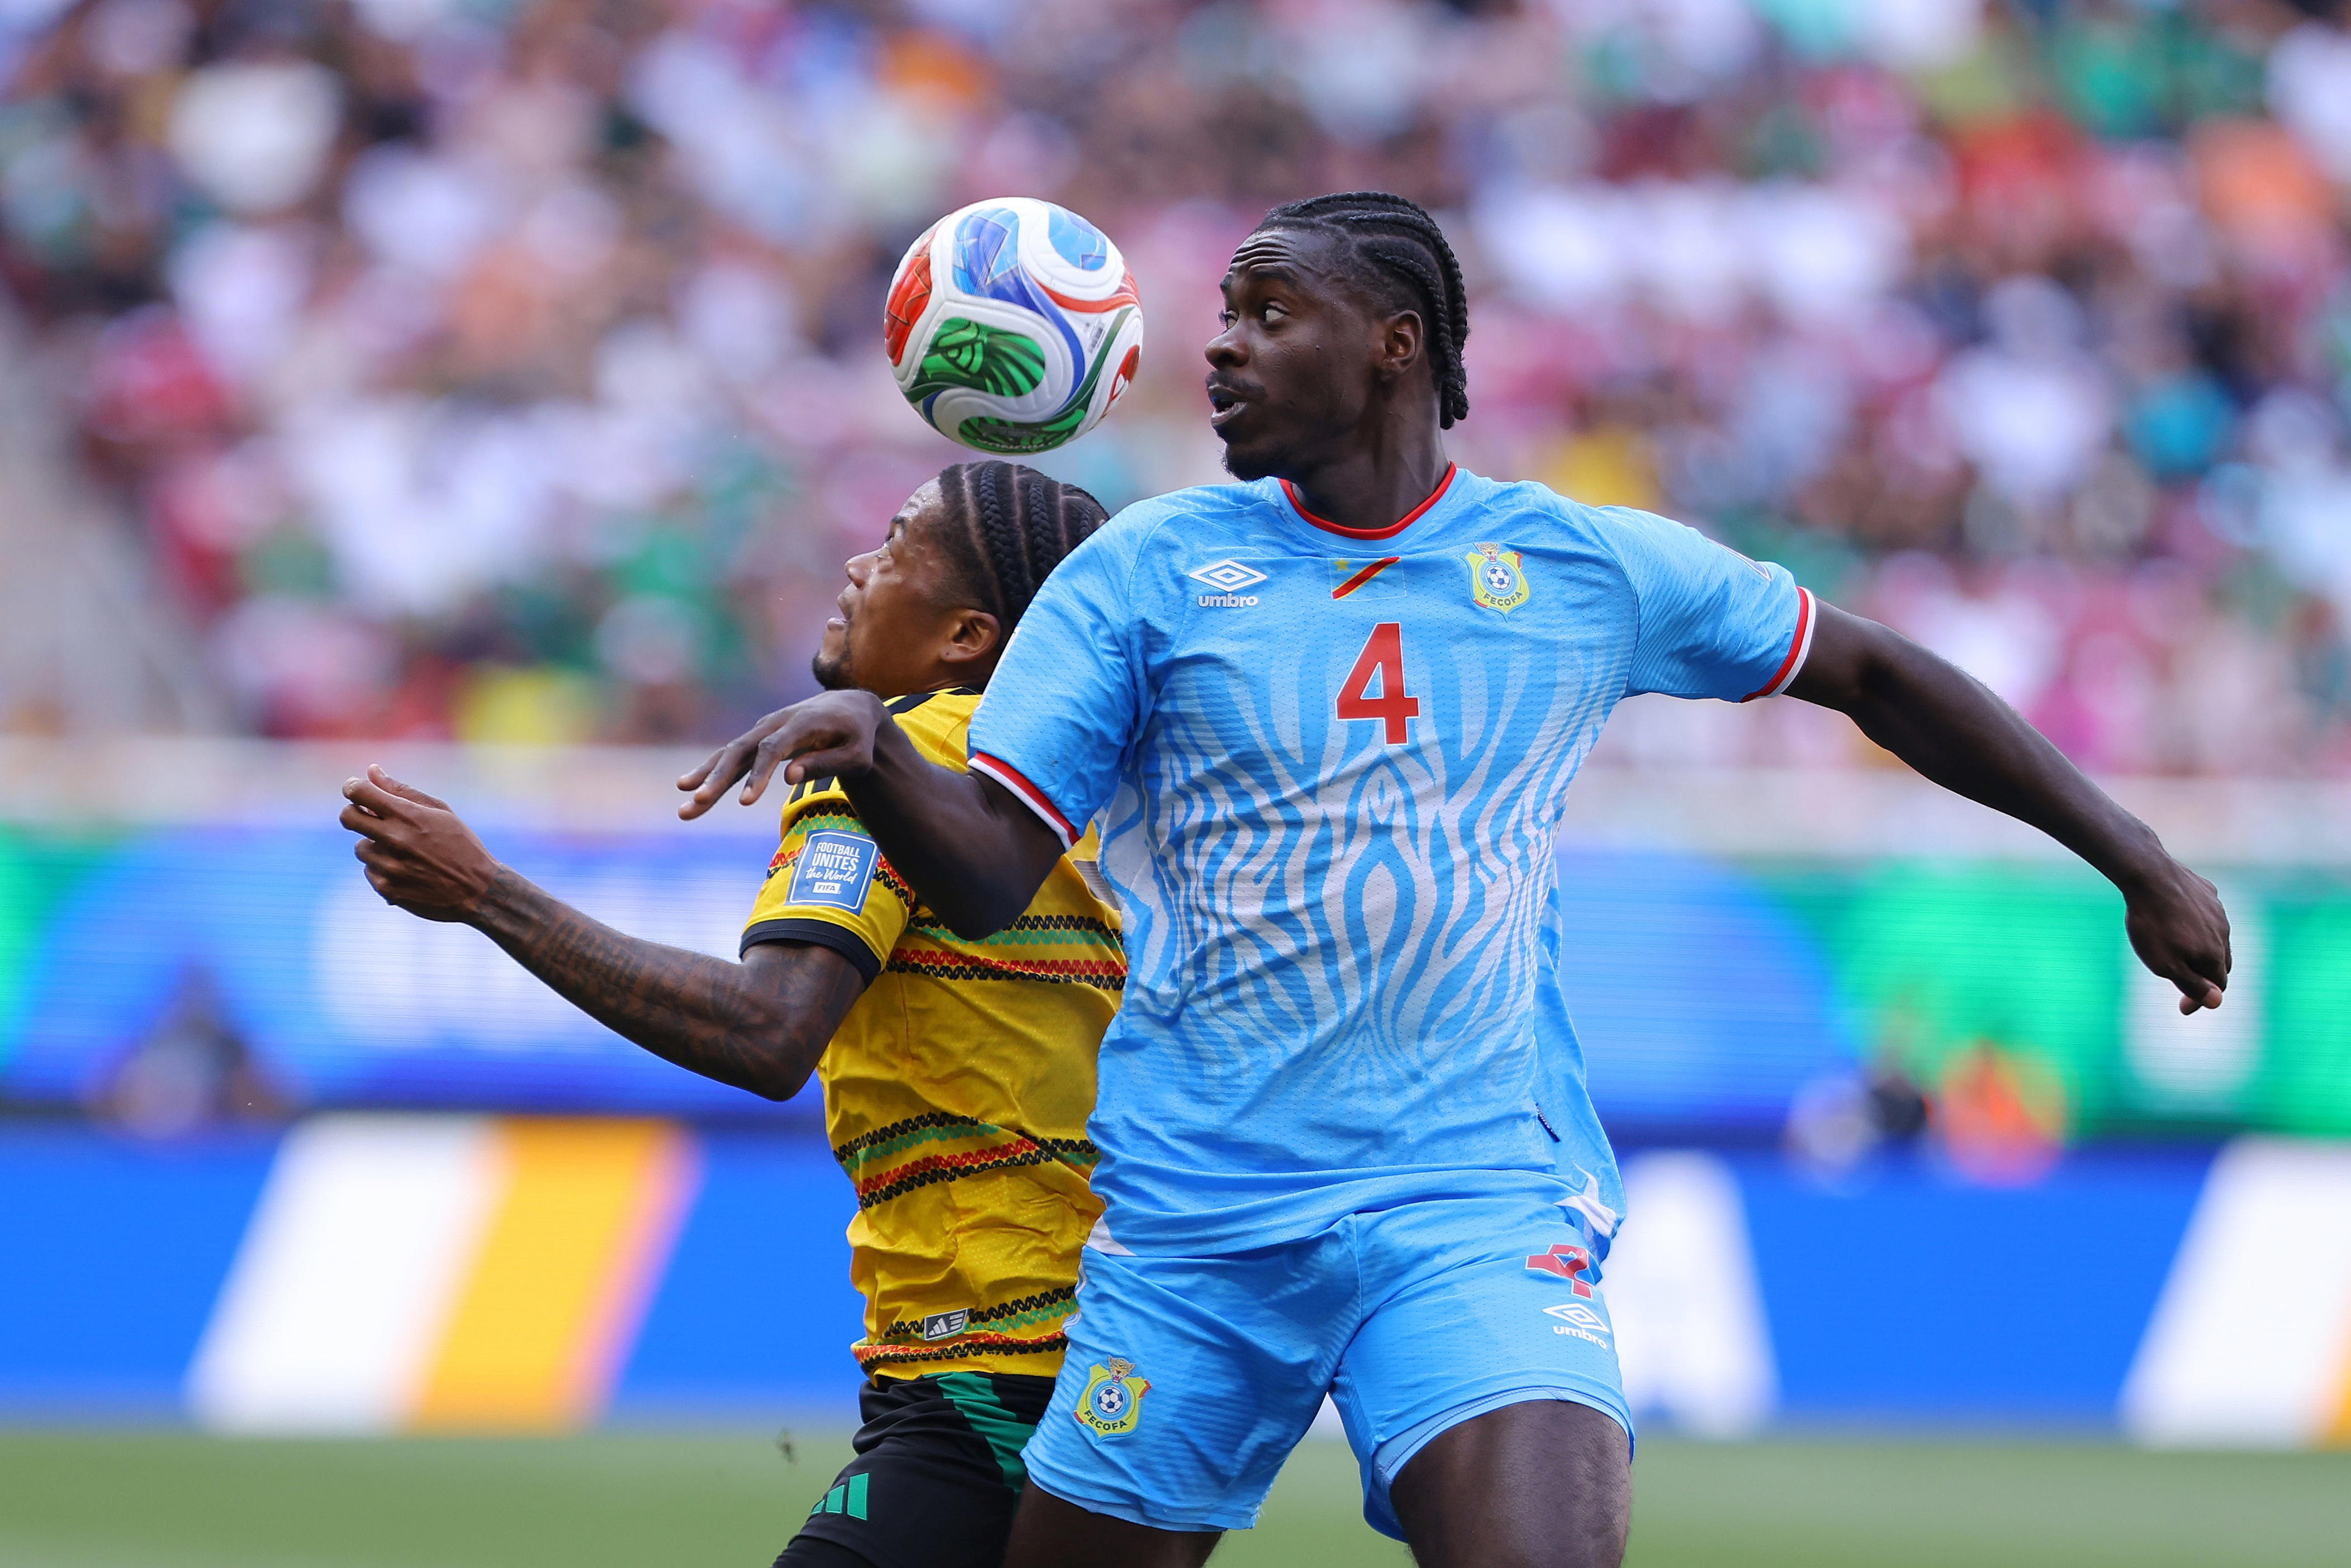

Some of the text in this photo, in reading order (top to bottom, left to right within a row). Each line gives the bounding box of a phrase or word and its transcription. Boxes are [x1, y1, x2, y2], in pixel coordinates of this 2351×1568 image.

[1197, 593, 1259, 608] umbro
[1483, 591, 1523, 607] FECOFA
[1334, 621, 1420, 746] 4
[815, 841, 861, 858] FOOTBALL
[812, 852, 859, 872] UNITES
[805, 865, 858, 885] the World
[1524, 1244, 1592, 1300] 4
[1552, 1325, 1608, 1350] umbro
[1083, 1409, 1128, 1431] FECOFA
